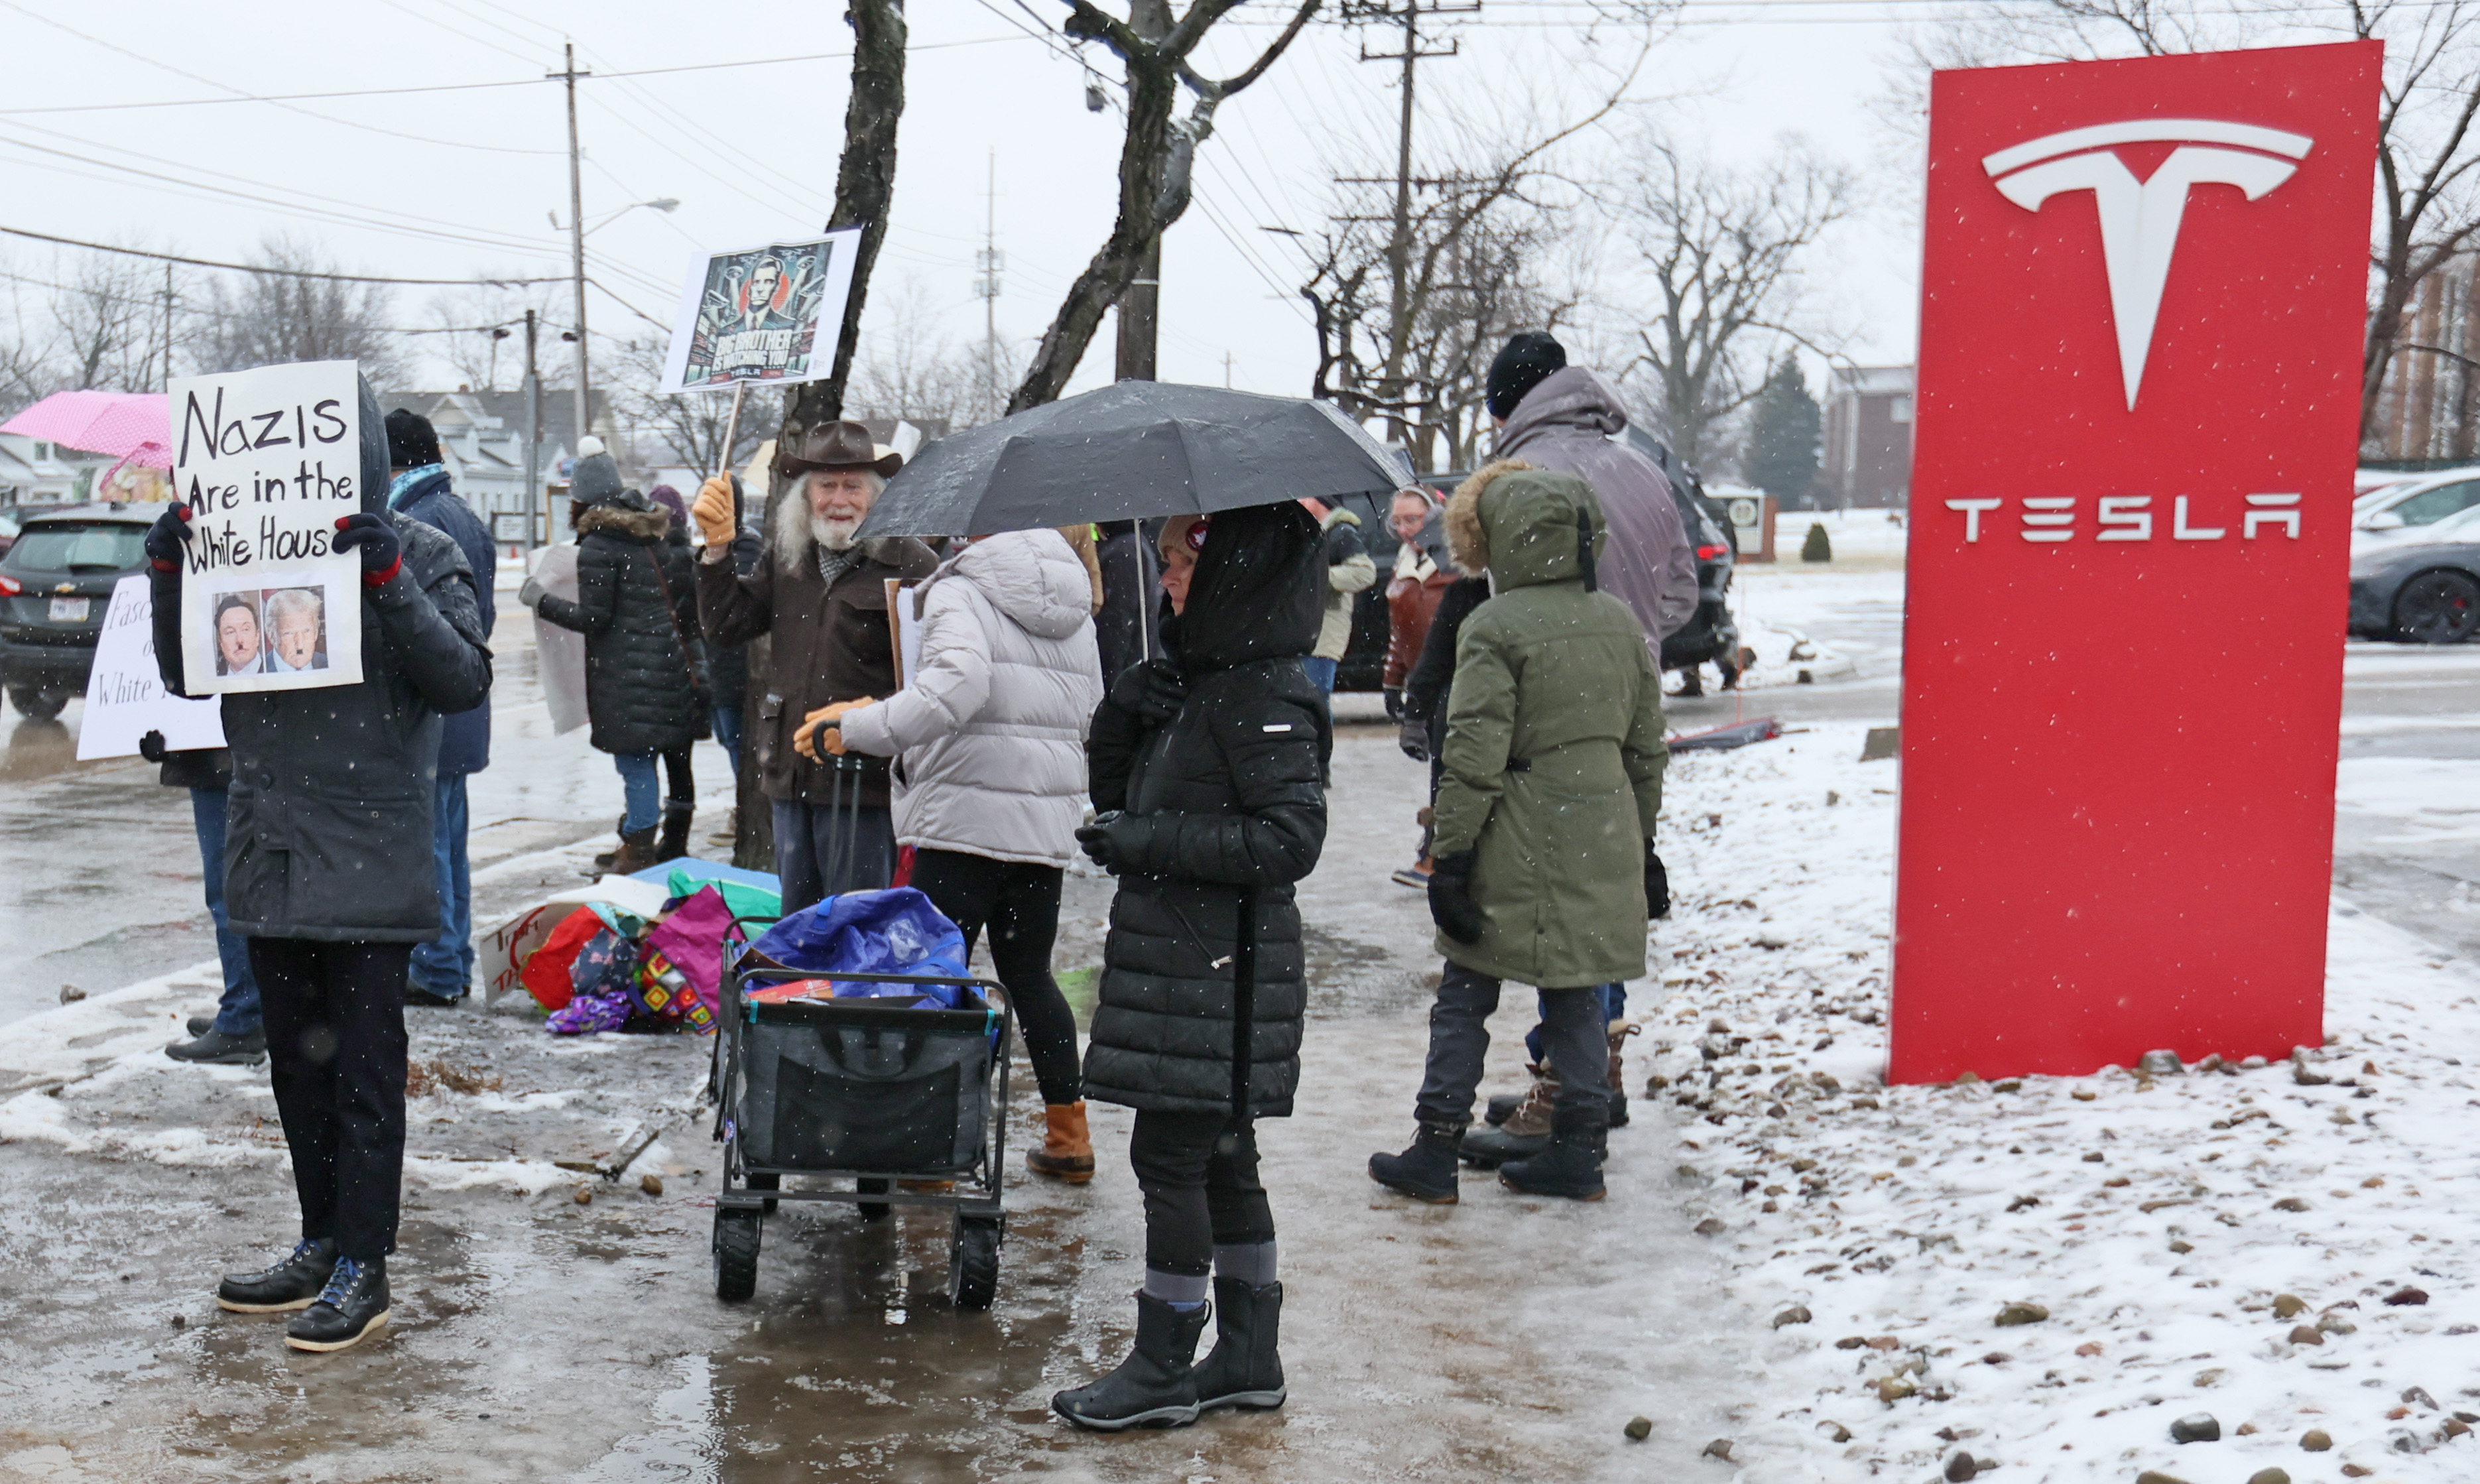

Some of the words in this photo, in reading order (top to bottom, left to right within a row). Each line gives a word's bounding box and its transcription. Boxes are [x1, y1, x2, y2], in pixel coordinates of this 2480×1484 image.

[712, 356, 723, 372] IS
[723, 350, 768, 370] WATCHING
[768, 350, 789, 366] YOU
[715, 334, 736, 357] BIG
[734, 329, 792, 352] BROTHER
[730, 368, 761, 378] TESLA
[189, 473, 239, 516] Are
[255, 471, 285, 503] in
[294, 460, 353, 499] the
[1944, 493, 2302, 543] TESLA
[185, 520, 252, 575] White
[259, 515, 328, 560] Hous
[99, 672, 151, 708] White
